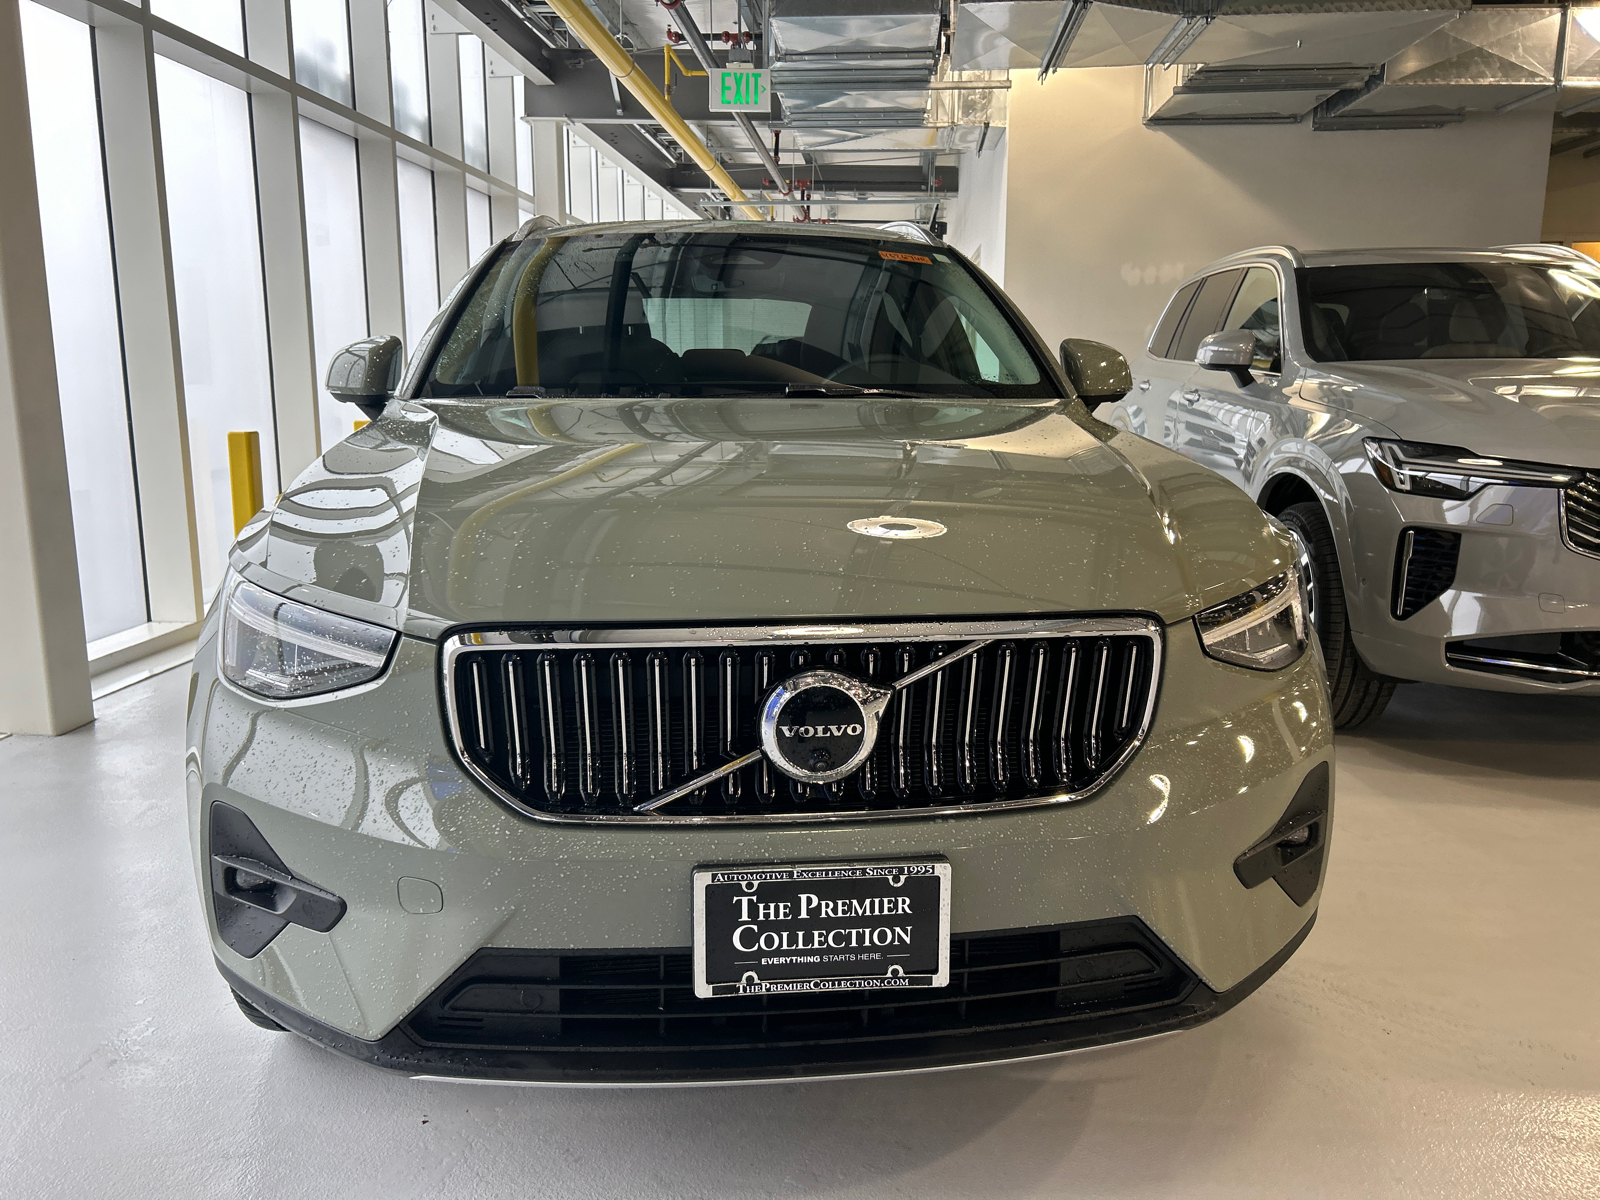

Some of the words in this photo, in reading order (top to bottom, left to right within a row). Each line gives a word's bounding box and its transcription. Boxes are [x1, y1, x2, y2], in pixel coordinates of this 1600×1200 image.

[721, 72, 762, 105] EXIT
[778, 723, 863, 738] VOLVO
[714, 872, 790, 883] AUTOMOTIVE
[792, 869, 863, 879] EXCELLENCE
[865, 866, 899, 876] SINCE
[902, 865, 933, 875] 1995
[732, 895, 792, 922] THE
[797, 893, 913, 919] PREMIER
[732, 925, 913, 952] COLLECTION
[761, 955, 821, 965] EVERYTHING
[822, 953, 856, 963] STARTS
[857, 952, 884, 961] HERE.
